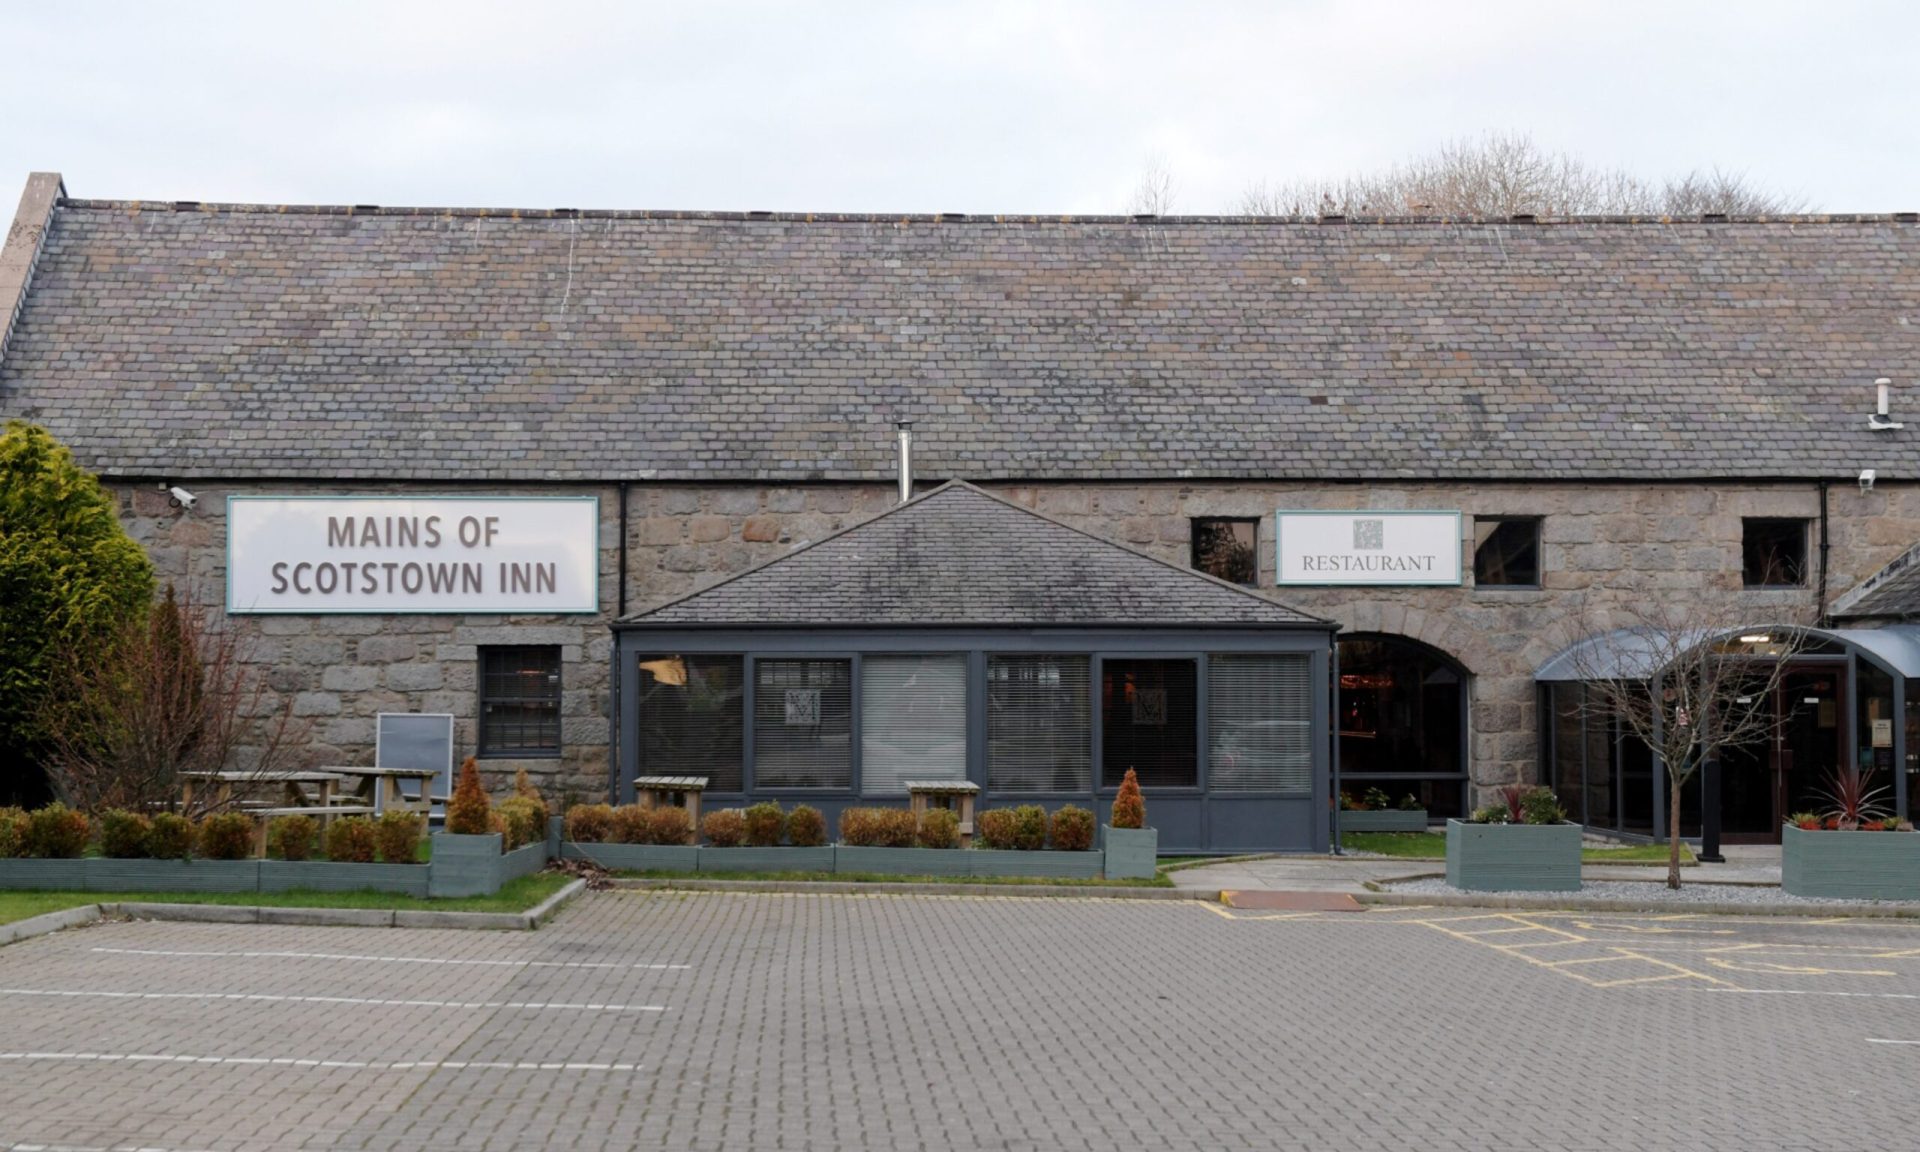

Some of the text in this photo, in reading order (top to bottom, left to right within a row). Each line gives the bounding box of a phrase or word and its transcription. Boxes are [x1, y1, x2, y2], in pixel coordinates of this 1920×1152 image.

[328, 515, 500, 548] MAINS OF
[271, 562, 556, 595] SCOTSTOWN INN
[1302, 554, 1436, 572] RESTAURANT
